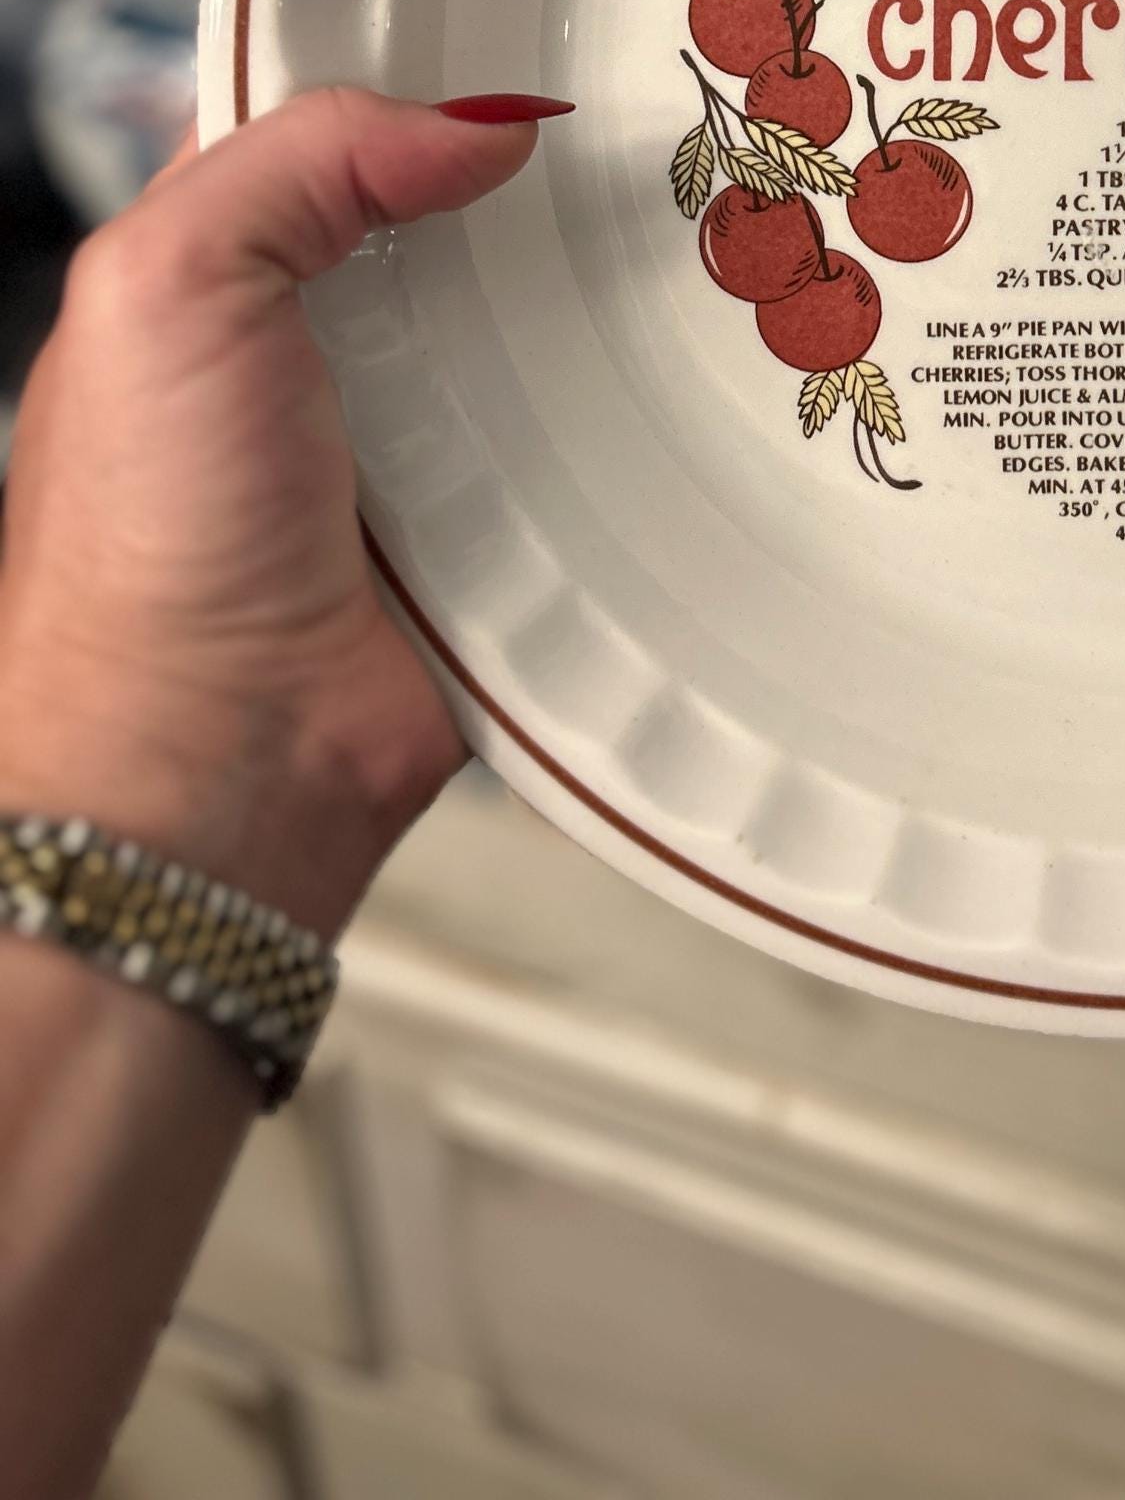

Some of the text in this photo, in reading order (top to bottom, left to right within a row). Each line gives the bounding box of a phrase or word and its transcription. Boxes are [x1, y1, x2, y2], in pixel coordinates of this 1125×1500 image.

[1078, 170, 1088, 188] 1
[1055, 194, 1068, 212] 4
[1072, 194, 1096, 212] C.
[1035, 268, 1083, 287] TBS.
[926, 322, 969, 338] LINE
[971, 322, 986, 338] A
[1017, 320, 1047, 337] PIE
[1052, 320, 1093, 336] PAN
[952, 343, 1079, 361] REFRIGERATE
[910, 366, 1010, 386] CHERRIES;
[1015, 365, 1066, 382] TOSS
[943, 389, 1012, 406] LEMON
[1018, 387, 1071, 408] JUICE
[1076, 388, 1091, 404] &
[943, 411, 991, 428] MIN.
[998, 410, 1056, 427] POUR
[1061, 410, 1113, 426] INTO
[994, 433, 1073, 451] BUTTER.
[1002, 456, 1070, 473] EDGES.
[1027, 478, 1074, 495] MIN.
[1079, 478, 1105, 495] AT
